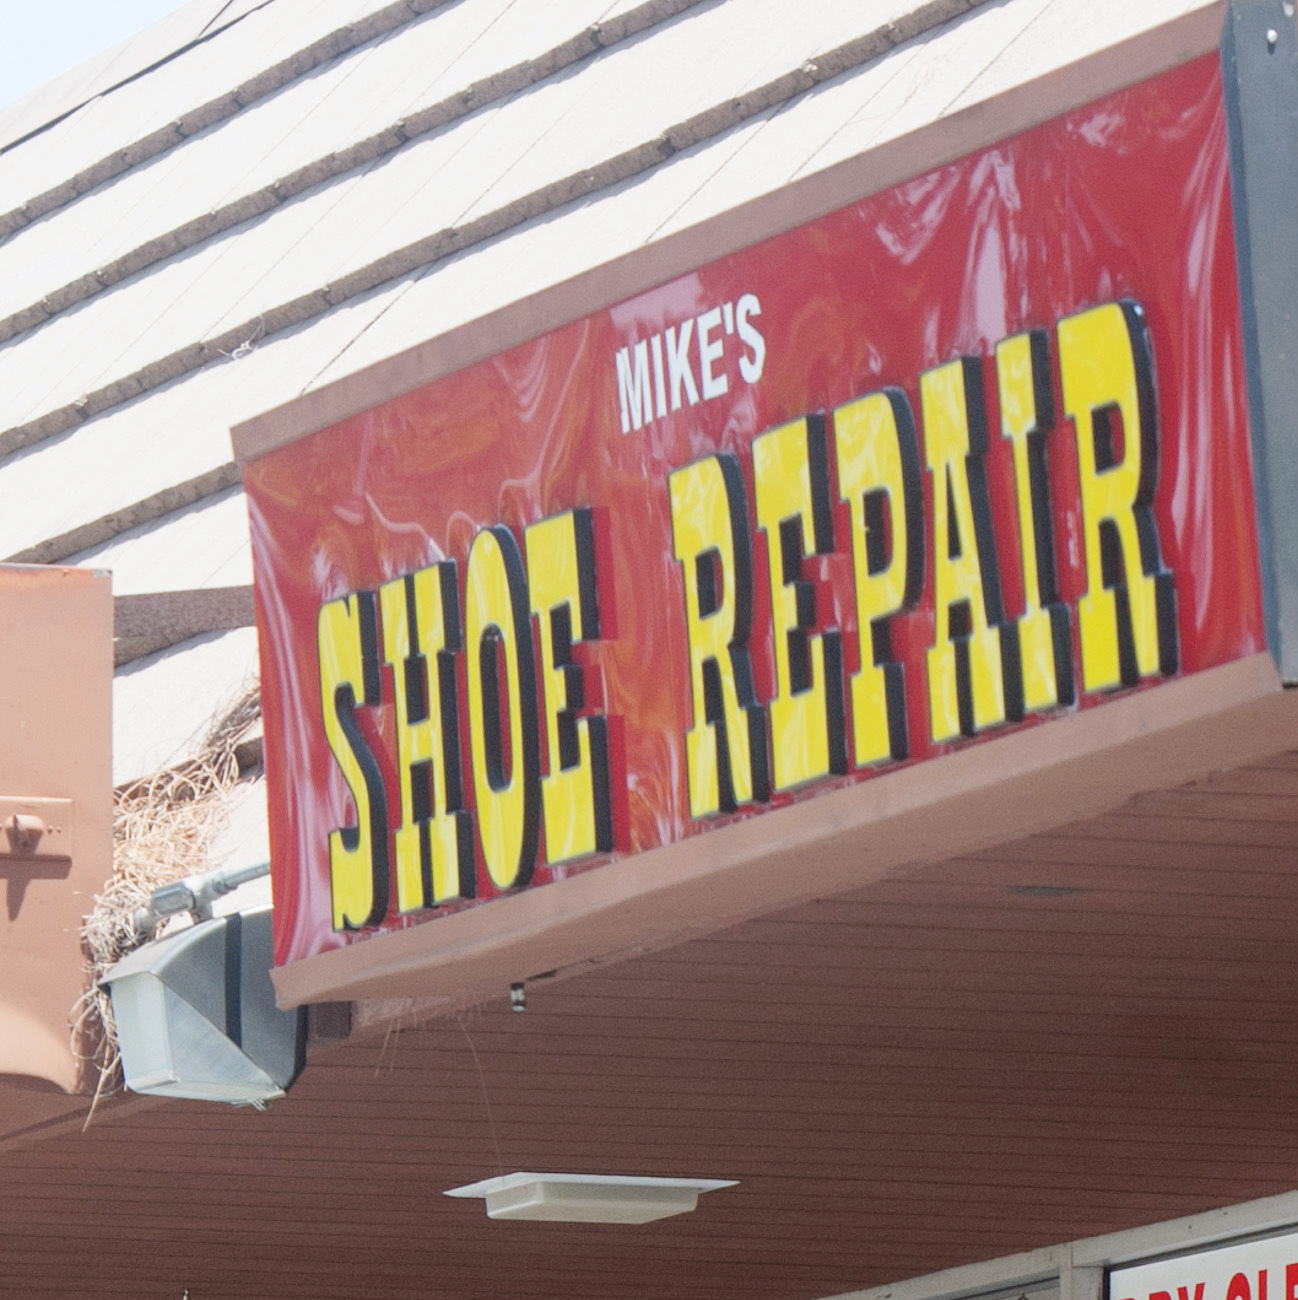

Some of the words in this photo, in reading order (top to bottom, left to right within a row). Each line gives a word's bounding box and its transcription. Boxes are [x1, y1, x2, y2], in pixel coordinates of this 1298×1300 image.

[616, 292, 766, 433] MIKE'S
[317, 507, 614, 931] SHOE
[668, 298, 1178, 819] REPAIR
